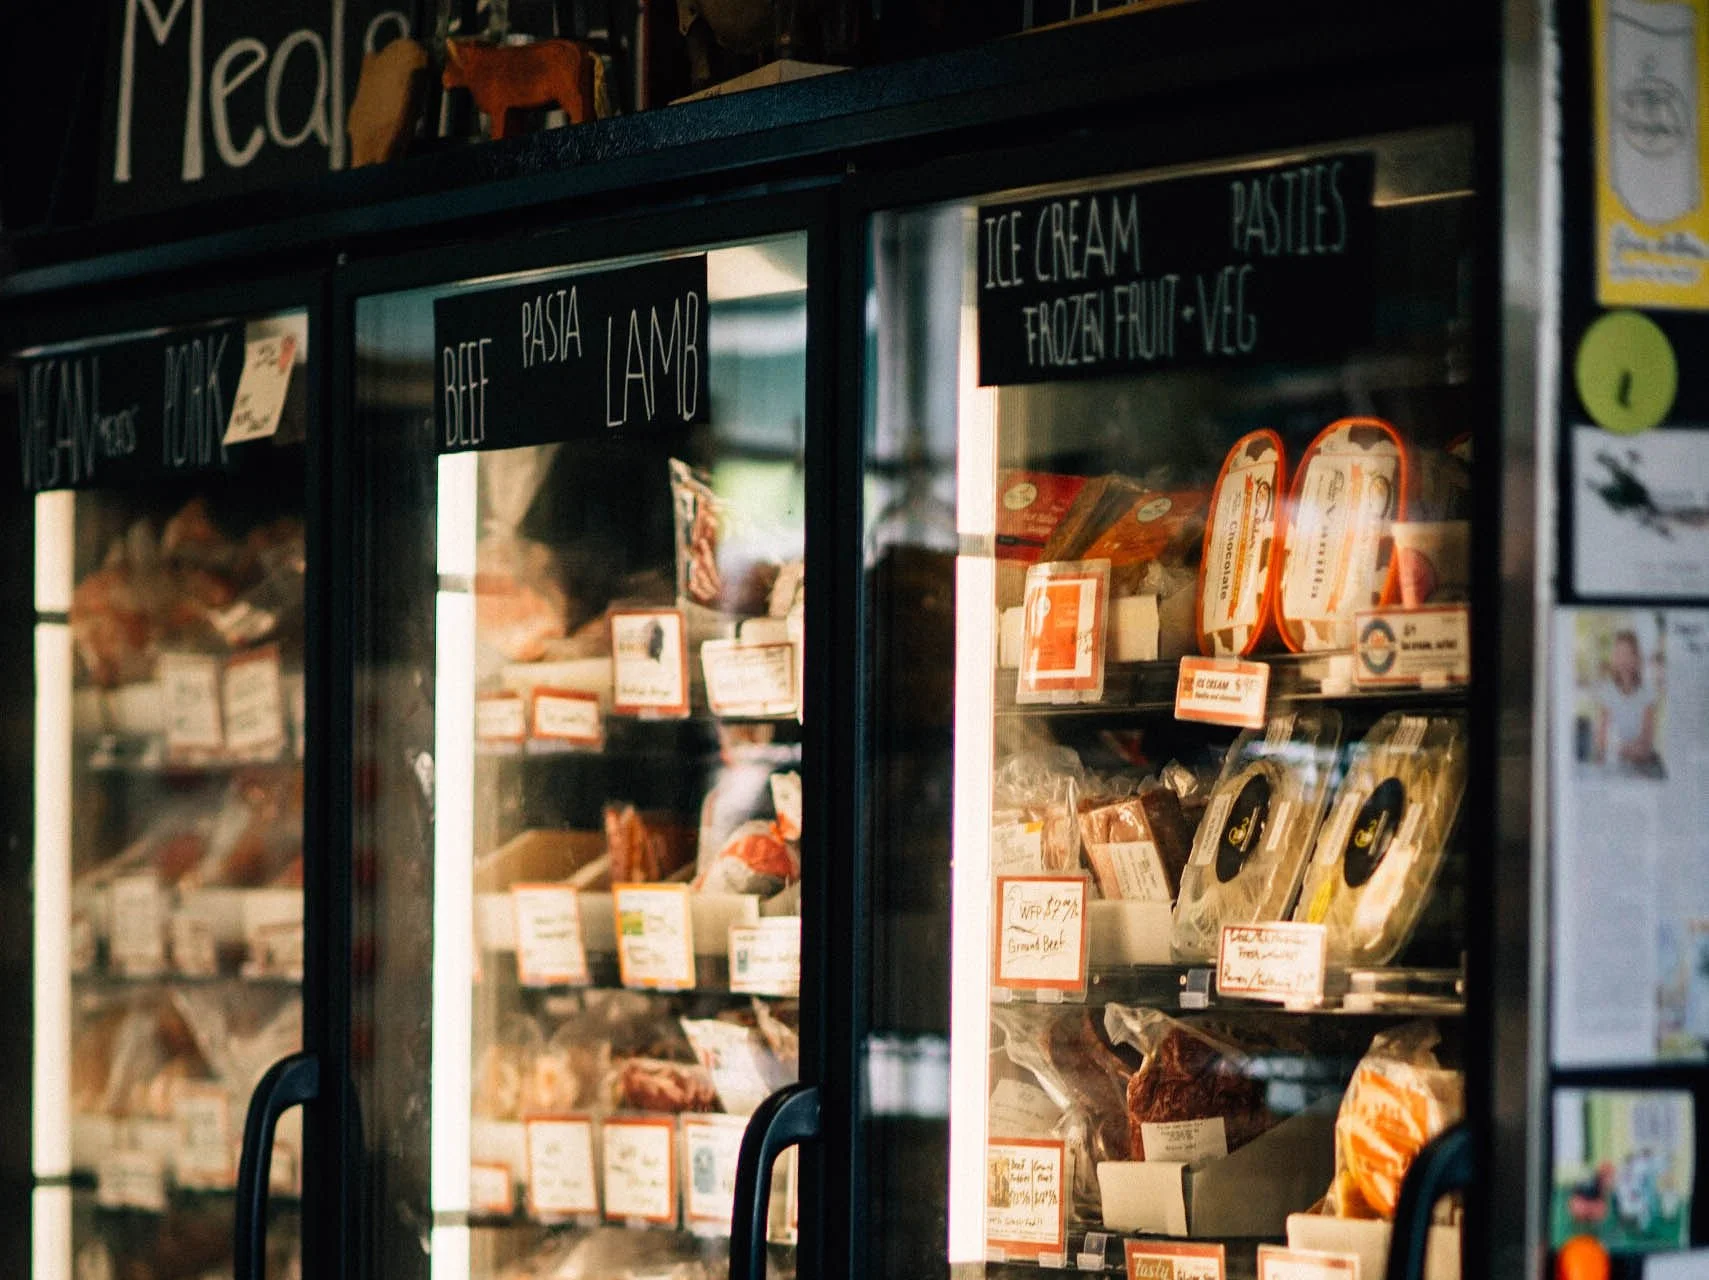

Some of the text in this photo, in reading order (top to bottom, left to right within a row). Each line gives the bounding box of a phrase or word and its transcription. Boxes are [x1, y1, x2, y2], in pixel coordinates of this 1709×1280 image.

[984, 161, 1347, 290] ICE CREAM PASTIES
[442, 285, 700, 447] BEEF PASTA LAMB
[1023, 289, 1105, 368] FROZEN
[1113, 273, 1180, 361] FRUIT
[1196, 263, 1258, 355] VEG
[1219, 520, 1239, 601] Chocolate
